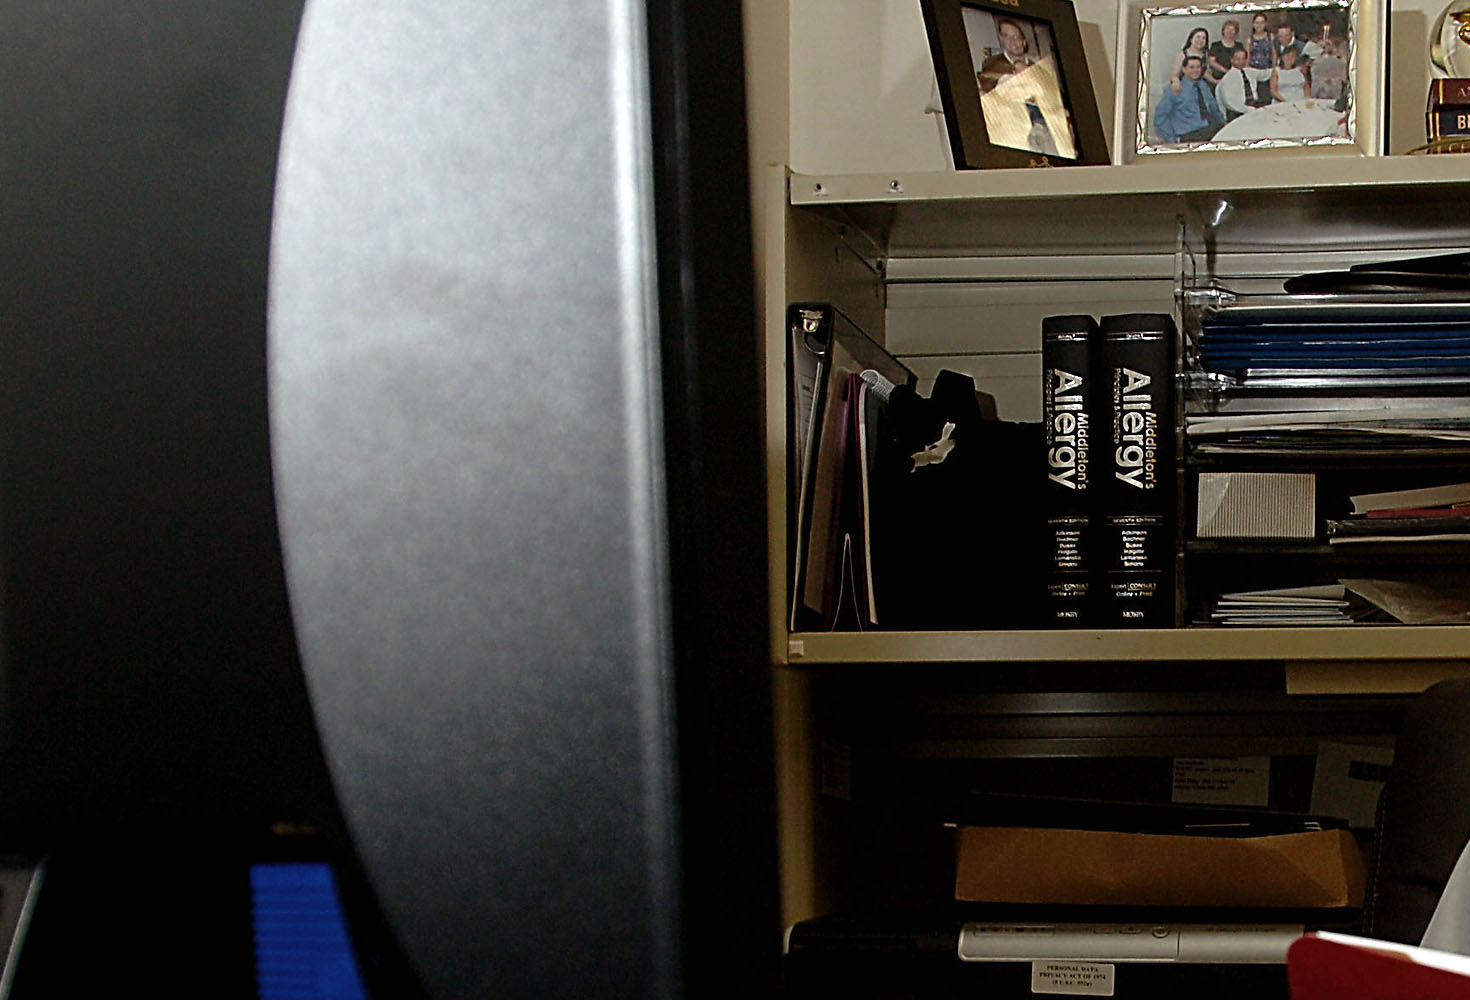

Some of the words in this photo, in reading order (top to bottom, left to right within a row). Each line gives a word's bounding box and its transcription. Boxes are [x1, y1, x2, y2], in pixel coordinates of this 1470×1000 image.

[1113, 367, 1121, 404] Principles
[1047, 368, 1084, 490] Allergy
[1077, 412, 1089, 490] Middleton's
[1113, 412, 1121, 445] Practice
[1115, 367, 1153, 489] Allergy
[1144, 411, 1158, 490] Middleton's
